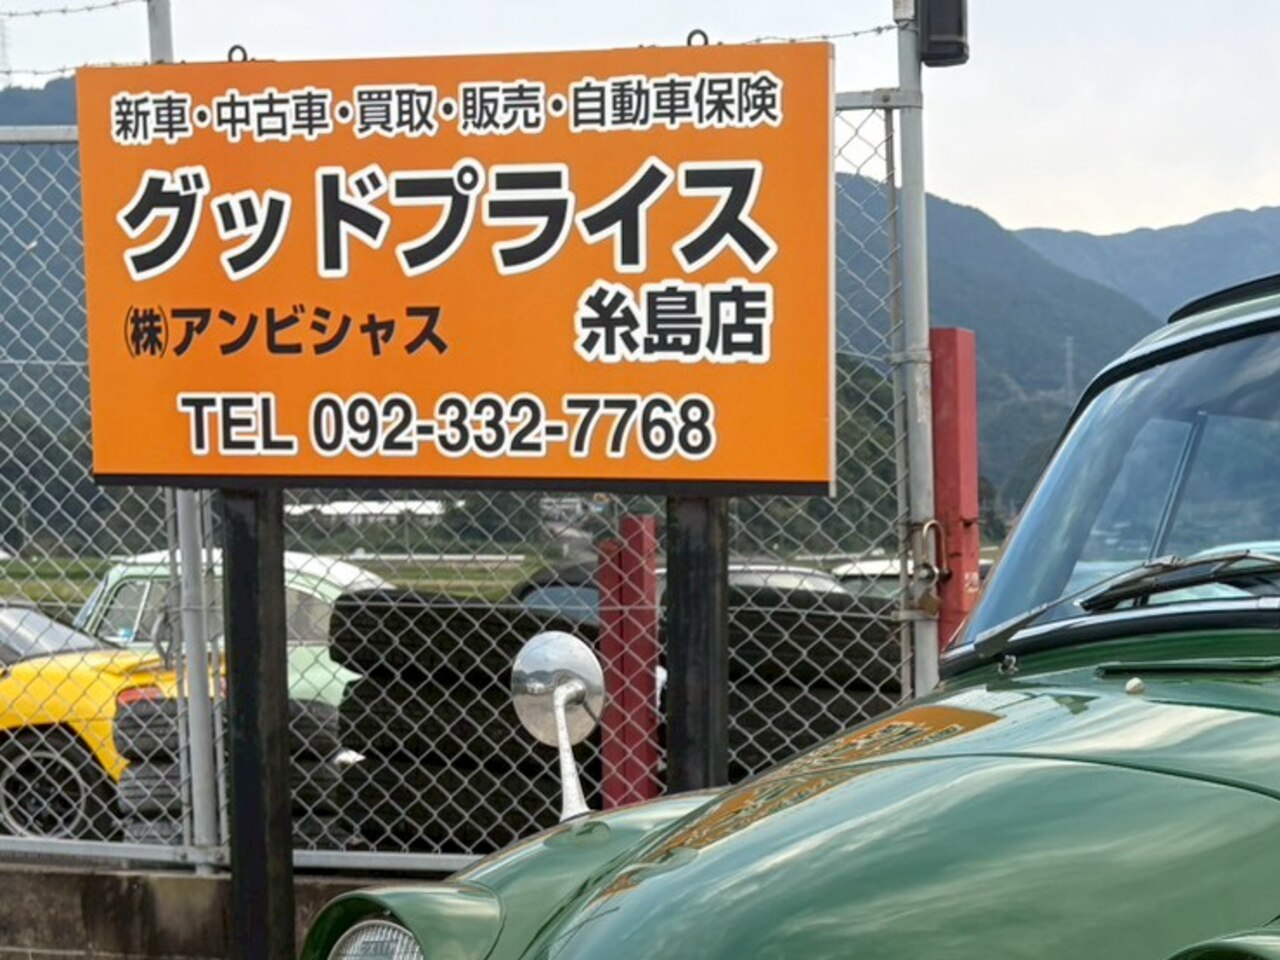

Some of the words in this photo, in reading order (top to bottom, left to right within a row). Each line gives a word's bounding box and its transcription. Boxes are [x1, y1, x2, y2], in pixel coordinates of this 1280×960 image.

[113, 75, 779, 142] 新車・中古車・買取・販売・自動車保険
[121, 163, 772, 276] グッドプライス
[580, 284, 768, 358] 糸島店
[180, 396, 295, 452] TEL
[312, 397, 713, 457] 092-332-7768
